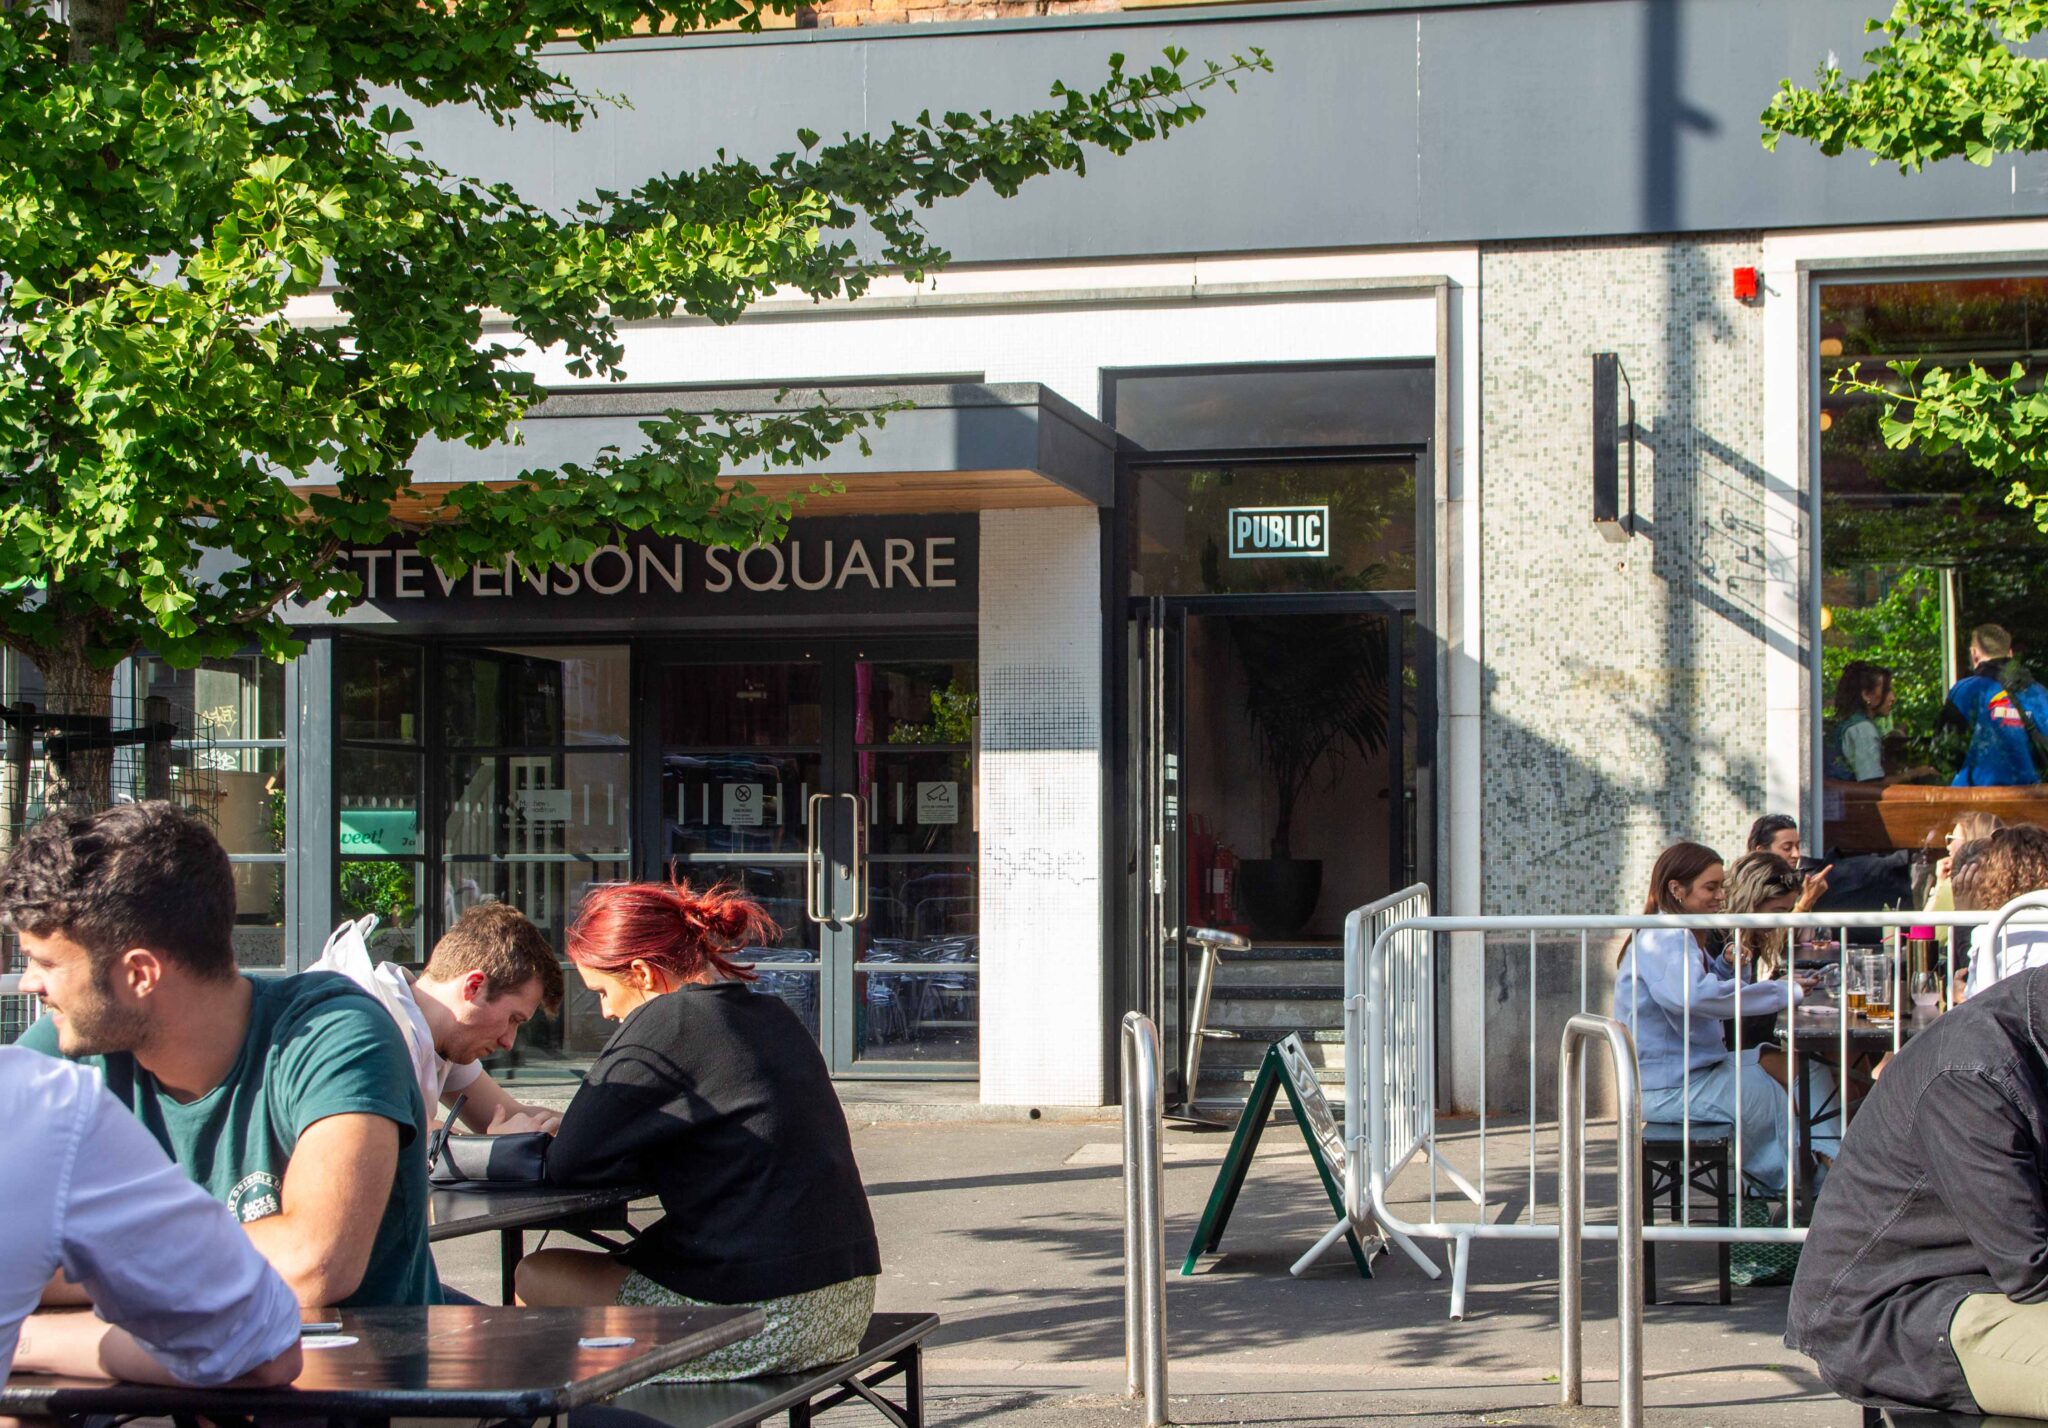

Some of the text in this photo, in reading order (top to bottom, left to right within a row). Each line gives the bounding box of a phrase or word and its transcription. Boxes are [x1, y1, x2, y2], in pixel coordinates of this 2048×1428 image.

[1237, 514, 1320, 548] PUBLIC
[333, 536, 957, 598] TEVENSON SQUARE
